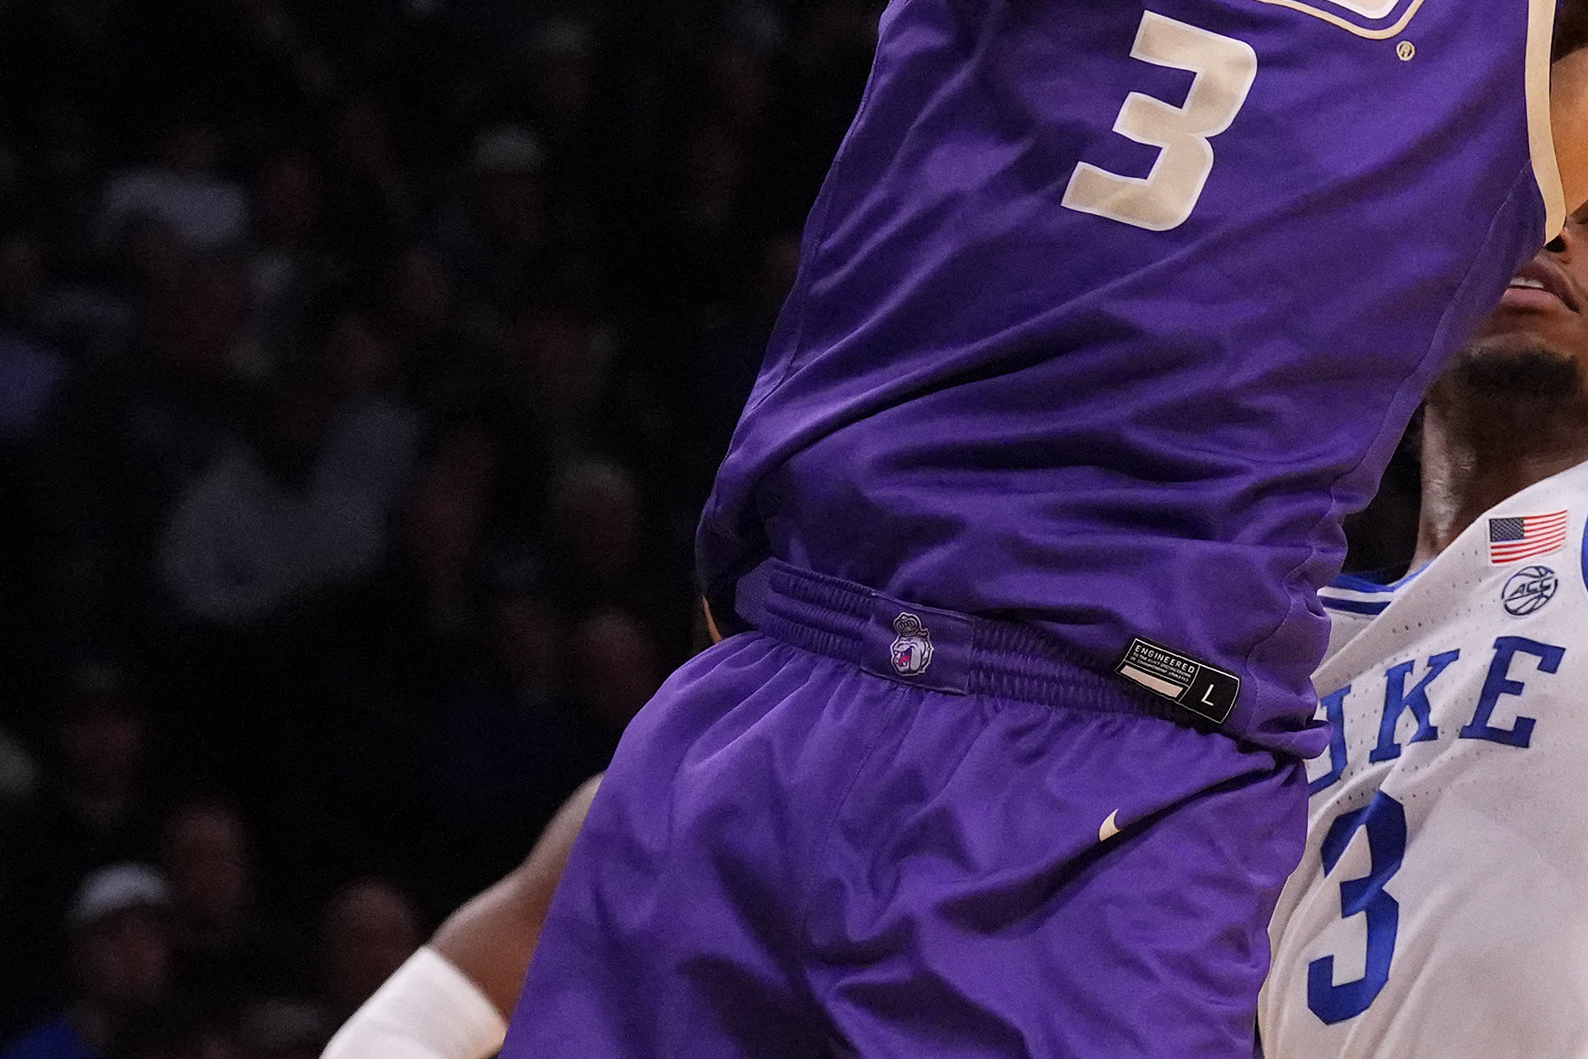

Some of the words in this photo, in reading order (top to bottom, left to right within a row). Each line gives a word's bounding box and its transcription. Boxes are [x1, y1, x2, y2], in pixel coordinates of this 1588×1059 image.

[1061, 9, 1258, 232] 3
[1134, 644, 1195, 674] ENGINEERED
[1201, 684, 1214, 706] L
[1307, 636, 1567, 798] UKE
[1307, 790, 1408, 1026] 3
